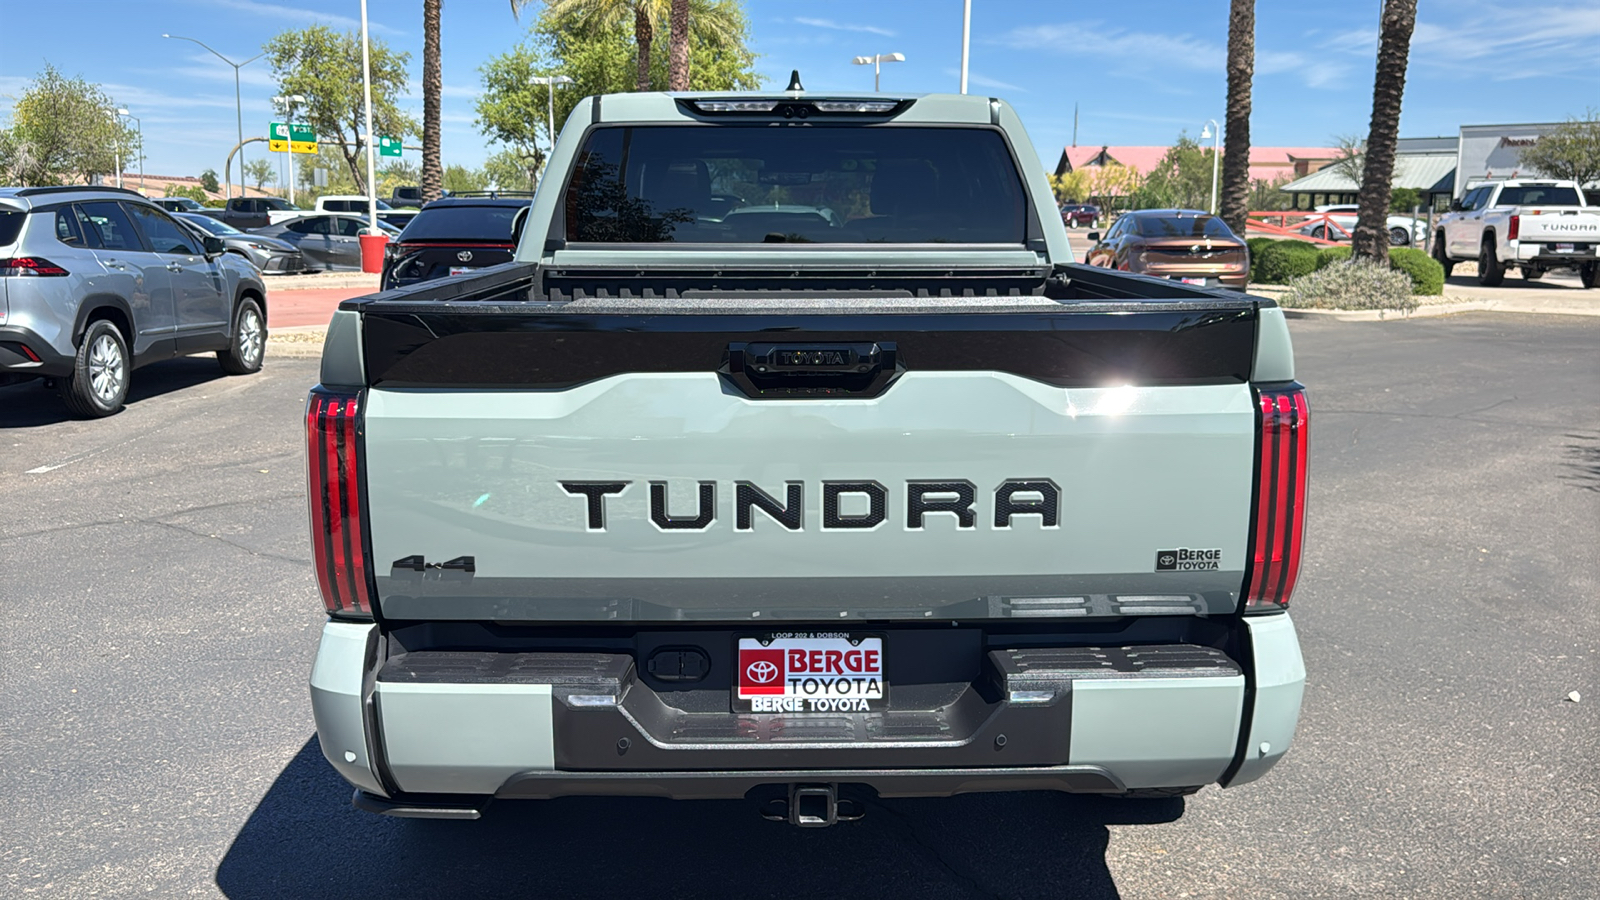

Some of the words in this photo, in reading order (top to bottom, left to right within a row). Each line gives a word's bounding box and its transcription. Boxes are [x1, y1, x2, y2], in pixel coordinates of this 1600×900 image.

[1541, 223, 1597, 231] TUNDRA
[781, 351, 844, 365] TOYOTA
[556, 478, 1062, 533] TUNDRA
[1178, 548, 1221, 561] BERGE
[1177, 560, 1219, 570] TOYOTA
[787, 648, 880, 676] BERGE
[787, 677, 881, 695] TOYOTA
[751, 696, 804, 713] BERGE
[807, 698, 870, 712] TOYOTA
